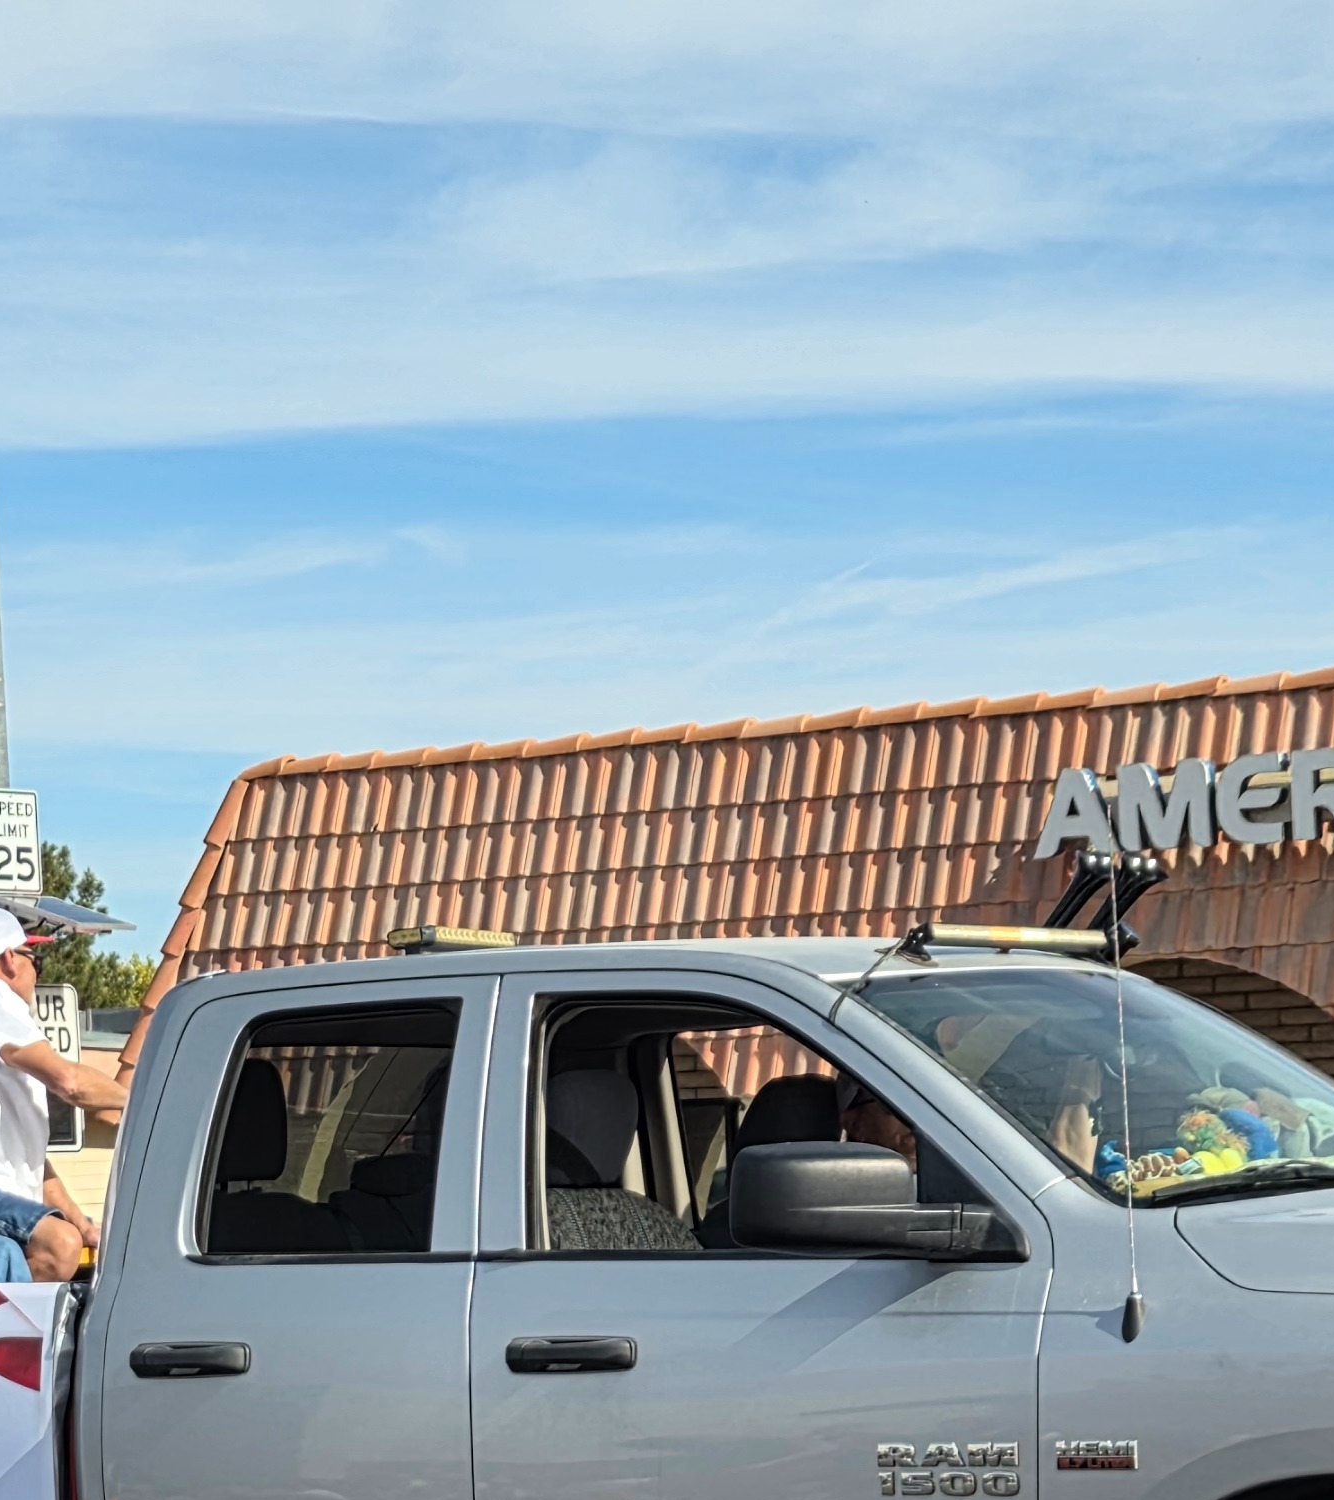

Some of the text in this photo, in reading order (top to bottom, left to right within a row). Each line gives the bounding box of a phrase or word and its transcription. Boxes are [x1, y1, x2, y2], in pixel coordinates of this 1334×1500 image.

[36, 995, 66, 1022] UR
[877, 1441, 1020, 1468] RAM
[878, 1470, 1021, 1496] 1500
